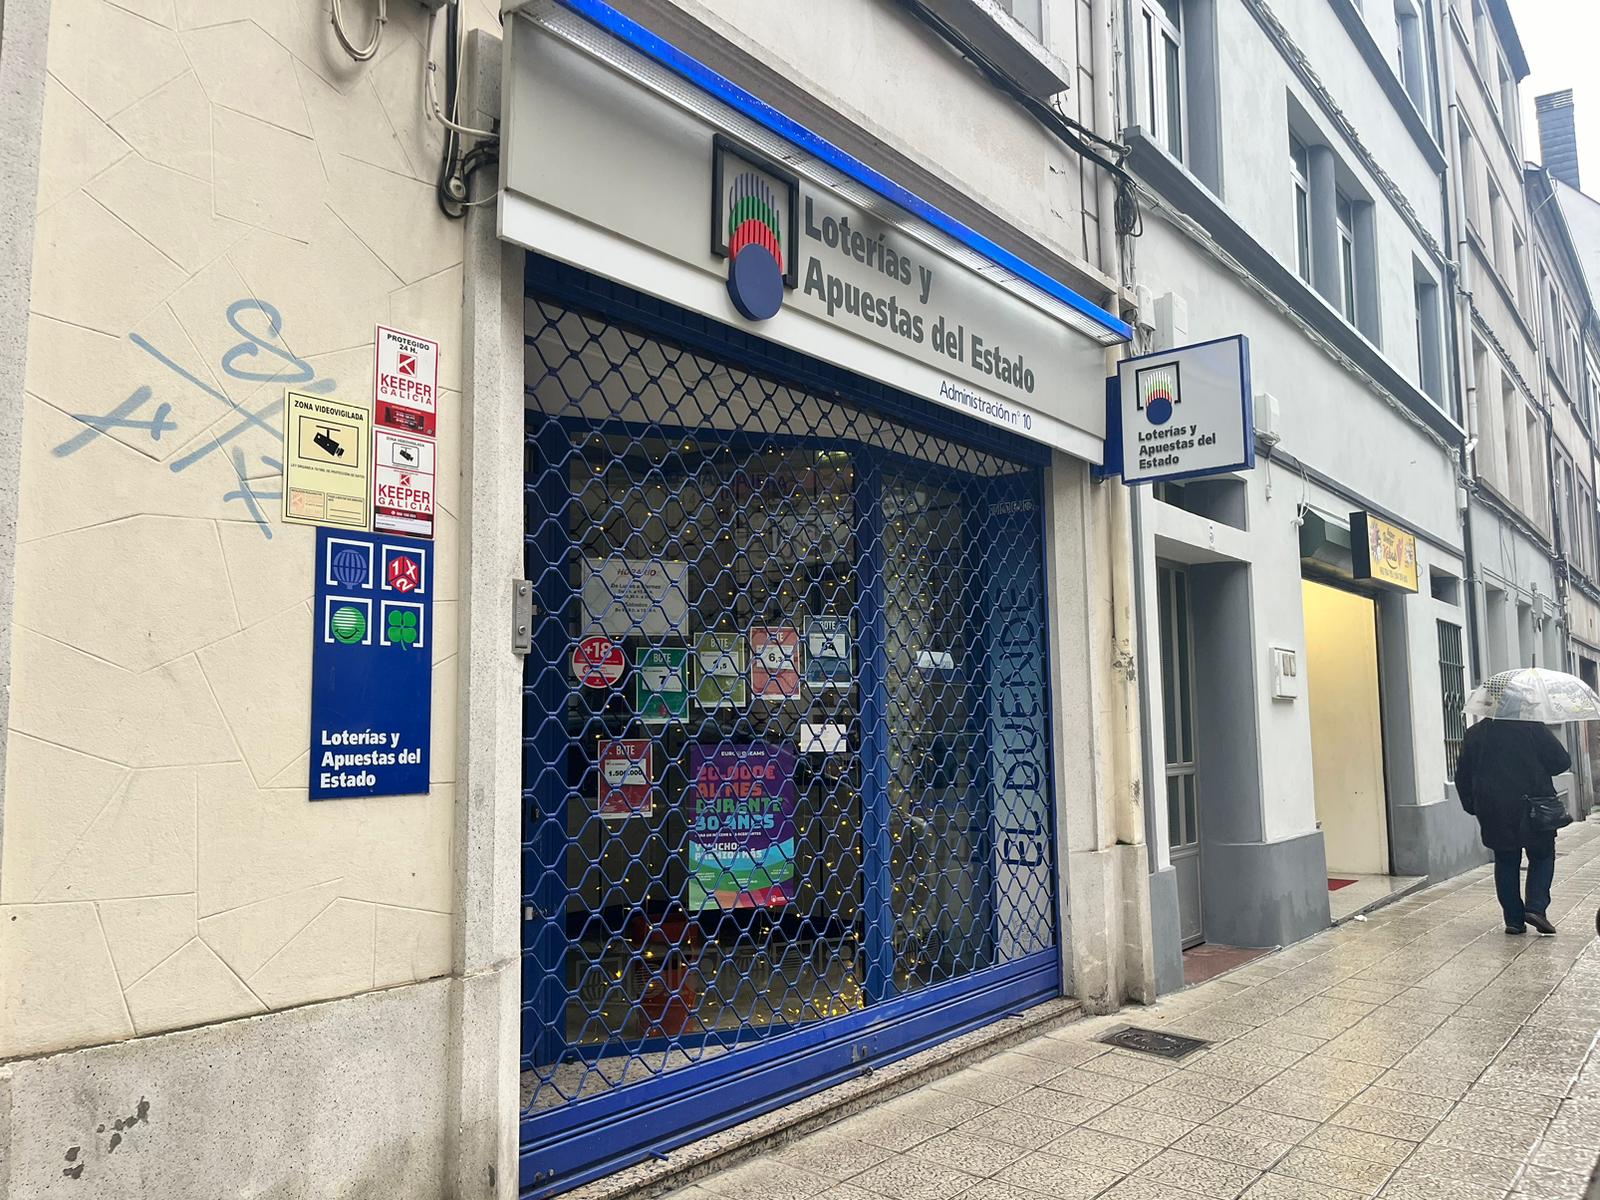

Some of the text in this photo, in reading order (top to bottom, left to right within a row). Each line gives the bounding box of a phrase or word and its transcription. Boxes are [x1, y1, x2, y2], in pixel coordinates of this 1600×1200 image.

[804, 195, 932, 304] Loterías y
[803, 256, 1035, 394] Apuestas del Estado
[387, 333, 430, 351] PROTEGIDO
[380, 373, 432, 398] KEEPER
[380, 386, 432, 405] GALICIA
[294, 400, 364, 421] ZONA VIDEOVIGILADA
[939, 380, 1010, 422] Administración
[1023, 413, 1032, 431] 10
[1138, 424, 1197, 442] Loterías y
[1139, 432, 1216, 457] Apuestas del
[1138, 454, 1180, 470] Estado
[379, 483, 430, 504] KEEPER
[378, 497, 431, 512] GALICIA
[584, 641, 613, 659] +18
[653, 653, 671, 663] BOTE
[996, 586, 1043, 867] EL DUENDE
[321, 728, 400, 748] Loterías y
[321, 748, 421, 771] Apuestas del
[616, 745, 635, 755] BOTE
[320, 770, 376, 789] Estado
[608, 769, 643, 777] 1.50.000
[696, 816, 719, 831] 30
